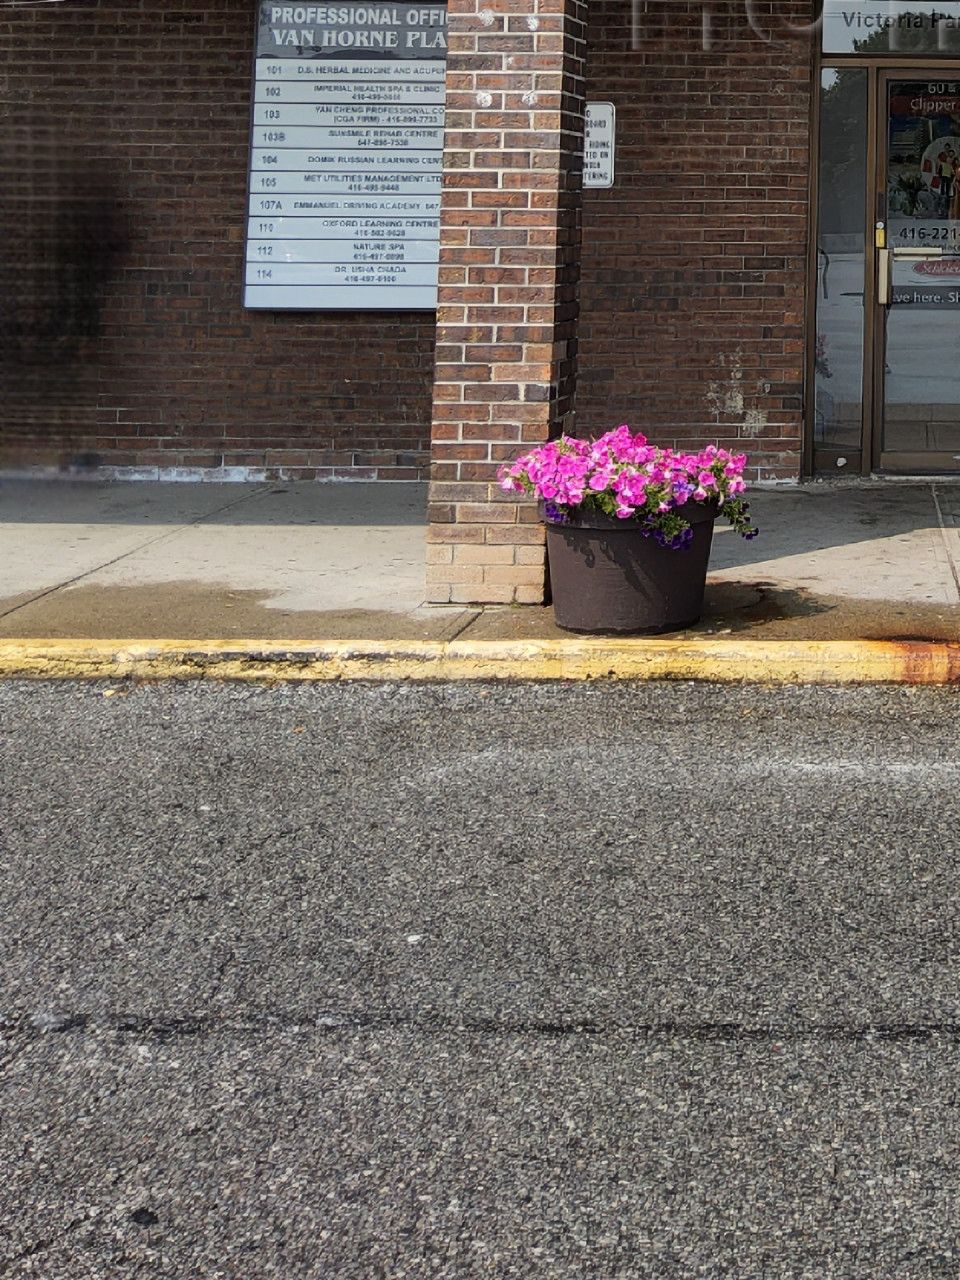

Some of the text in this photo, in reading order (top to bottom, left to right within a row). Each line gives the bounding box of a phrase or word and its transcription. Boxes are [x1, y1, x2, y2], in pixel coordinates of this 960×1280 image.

[271, 7, 448, 26] PROFESSIONAL OFFI
[842, 11, 922, 29] Victoria
[272, 29, 447, 48] VAN HORNE PLA
[267, 66, 281, 74] 101
[315, 66, 350, 74] HERBAL
[351, 67, 391, 75] MEDICINE
[393, 67, 411, 75] AND
[265, 87, 281, 97] 102
[313, 85, 351, 93] IMPERIAL
[928, 82, 944, 94] 60
[910, 97, 955, 112] Clipper
[264, 106, 445, 119] 103 YAN CHENG PROFESSIONAL CO
[262, 133, 286, 142] 103B
[262, 156, 278, 164] 104
[337, 156, 374, 164] RUSSIAN
[421, 157, 443, 165] CENT
[261, 178, 276, 187] 105
[364, 175, 424, 183] MANAGEMENT
[260, 201, 282, 210] 107A
[379, 202, 420, 210] ACADEMY
[259, 223, 273, 232] 110
[257, 247, 273, 256] 112
[257, 270, 272, 278] 114
[896, 293, 910, 303] ve
[914, 291, 945, 303] here.
